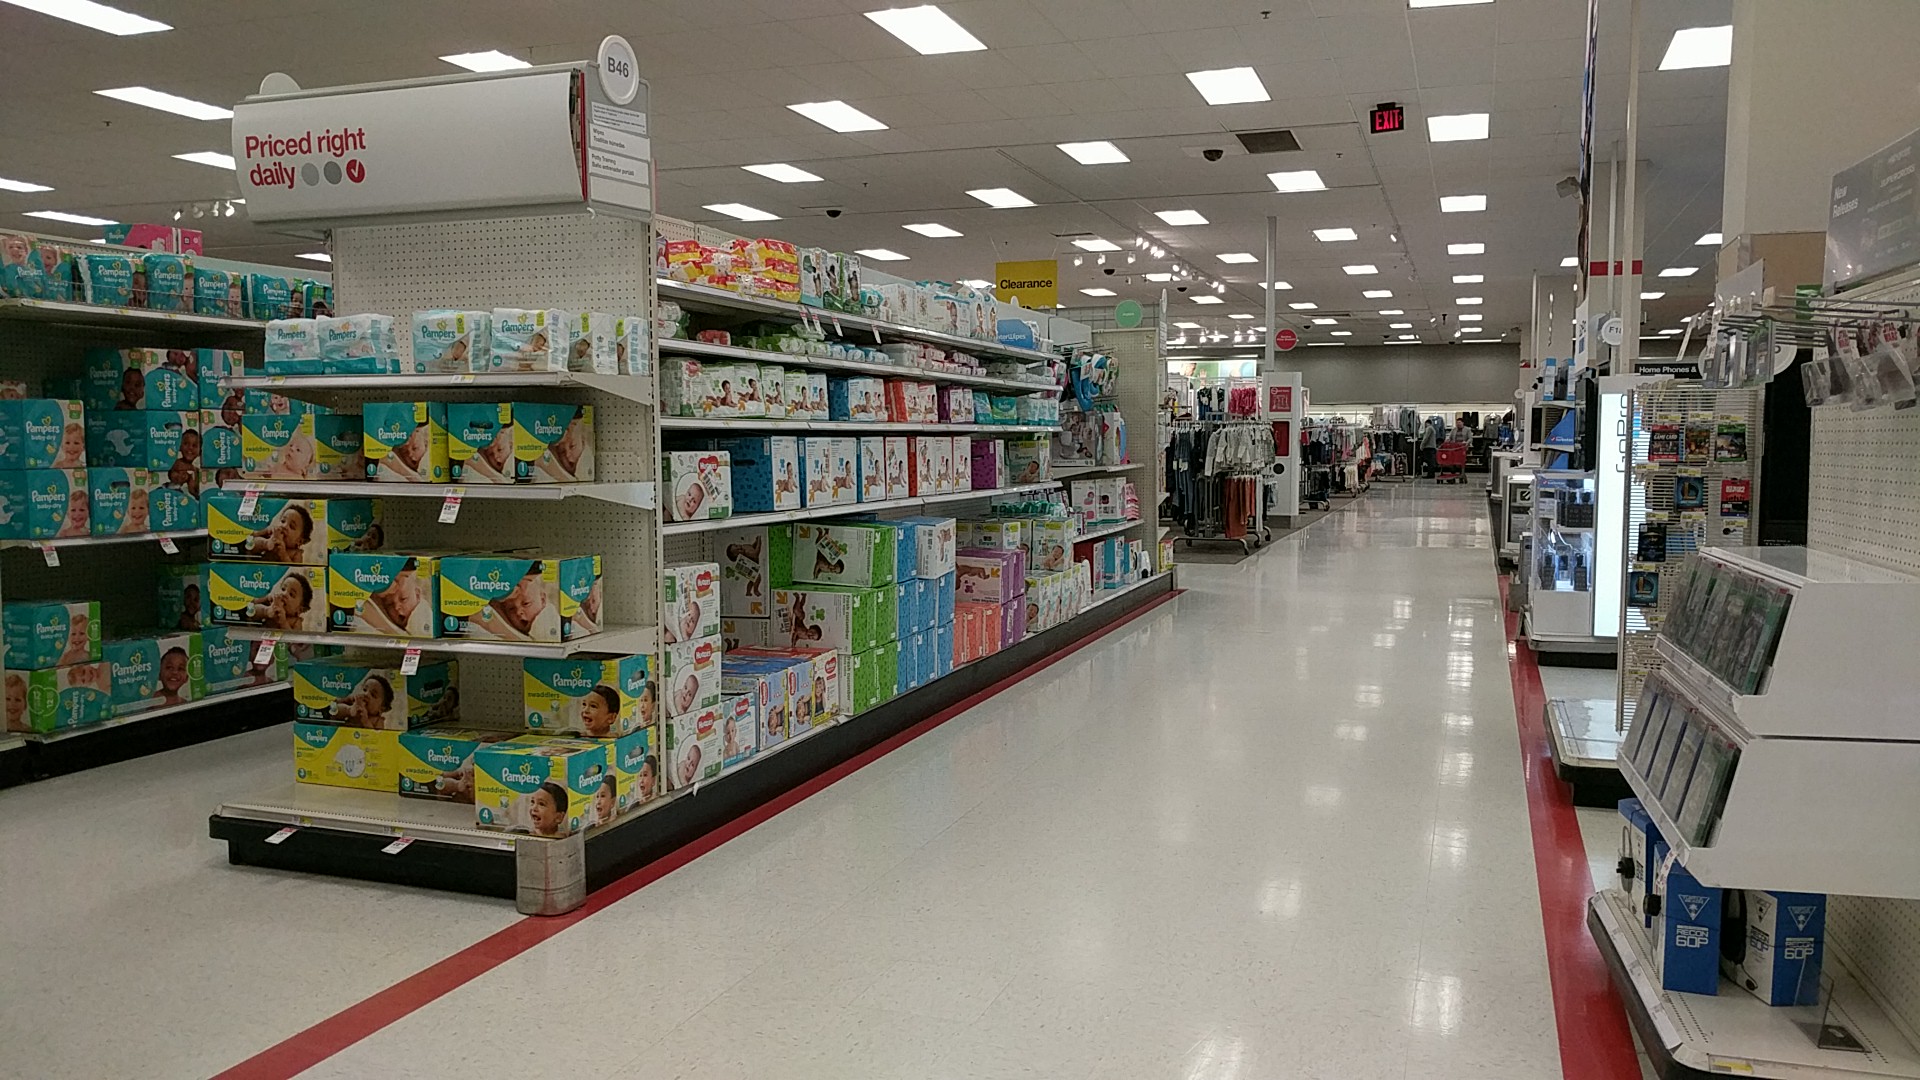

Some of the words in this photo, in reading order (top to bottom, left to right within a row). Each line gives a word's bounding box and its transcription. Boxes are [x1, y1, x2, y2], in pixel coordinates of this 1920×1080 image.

[608, 56, 629, 78] B46
[1375, 109, 1400, 131] EXIT
[245, 131, 312, 158] Priced
[317, 128, 366, 157] right
[249, 161, 295, 189] daily
[1833, 186, 1848, 201] New
[1832, 198, 1858, 218] Releases
[98, 264, 131, 278] Pampers
[154, 270, 183, 281] Pampers
[199, 277, 228, 289] Pampers
[1000, 279, 1053, 289] Clearance
[262, 284, 288, 296] Pampers
[421, 326, 456, 341] Pampers
[501, 320, 535, 334] Pampers
[277, 329, 307, 340] Pampers
[328, 329, 357, 341] Pampers
[89, 366, 119, 379] Pampers
[161, 373, 172, 408] Pampers
[25, 420, 60, 434] Pampers
[150, 427, 180, 439] Pampers
[261, 425, 290, 440] Pampers
[534, 421, 563, 436] Pampers
[31, 434, 57, 442] baby-dry
[378, 427, 407, 441] Pampers
[463, 428, 493, 442] Pampers
[1665, 432, 1678, 440] CARD
[331, 435, 360, 447] Pampers
[217, 431, 226, 465] Pampers
[247, 458, 254, 467] N
[31, 490, 66, 503] Pampers
[94, 488, 127, 501] Pampers
[37, 502, 62, 510] baby-dry
[162, 492, 173, 527] Pampers
[216, 528, 244, 536] swaddlers
[341, 519, 367, 532] Pampers
[239, 575, 271, 590] Pampers
[354, 568, 390, 585] Pampers
[469, 575, 511, 593] Pampers
[570, 584, 590, 597] Pampers
[334, 590, 365, 598] swaddlers
[444, 599, 480, 607] swaddlers
[36, 623, 66, 635] Pampers
[208, 643, 243, 659] Pampers
[213, 656, 239, 665] baby-dry
[112, 662, 152, 678] Pampers
[118, 675, 147, 685] baby-dry
[322, 675, 352, 691] Pampers
[552, 672, 592, 689] Pampers
[627, 678, 646, 692] Pampers
[33, 690, 41, 698] 12
[420, 686, 443, 699] Pampers
[528, 691, 560, 699] swaddlers
[67, 690, 80, 726] Pampers
[532, 713, 539, 723] 4
[306, 732, 328, 743] Pampers
[427, 749, 460, 765] Pampers
[624, 754, 646, 768] Pampers
[405, 768, 434, 776] swaddlers
[501, 767, 541, 785] Pampers
[578, 773, 603, 789] Pampers
[478, 786, 509, 794] swaddlers
[482, 810, 489, 820] 4
[1677, 929, 1709, 937] RECON
[1676, 936, 1709, 948] 60P
[1784, 947, 1814, 960] 60P
